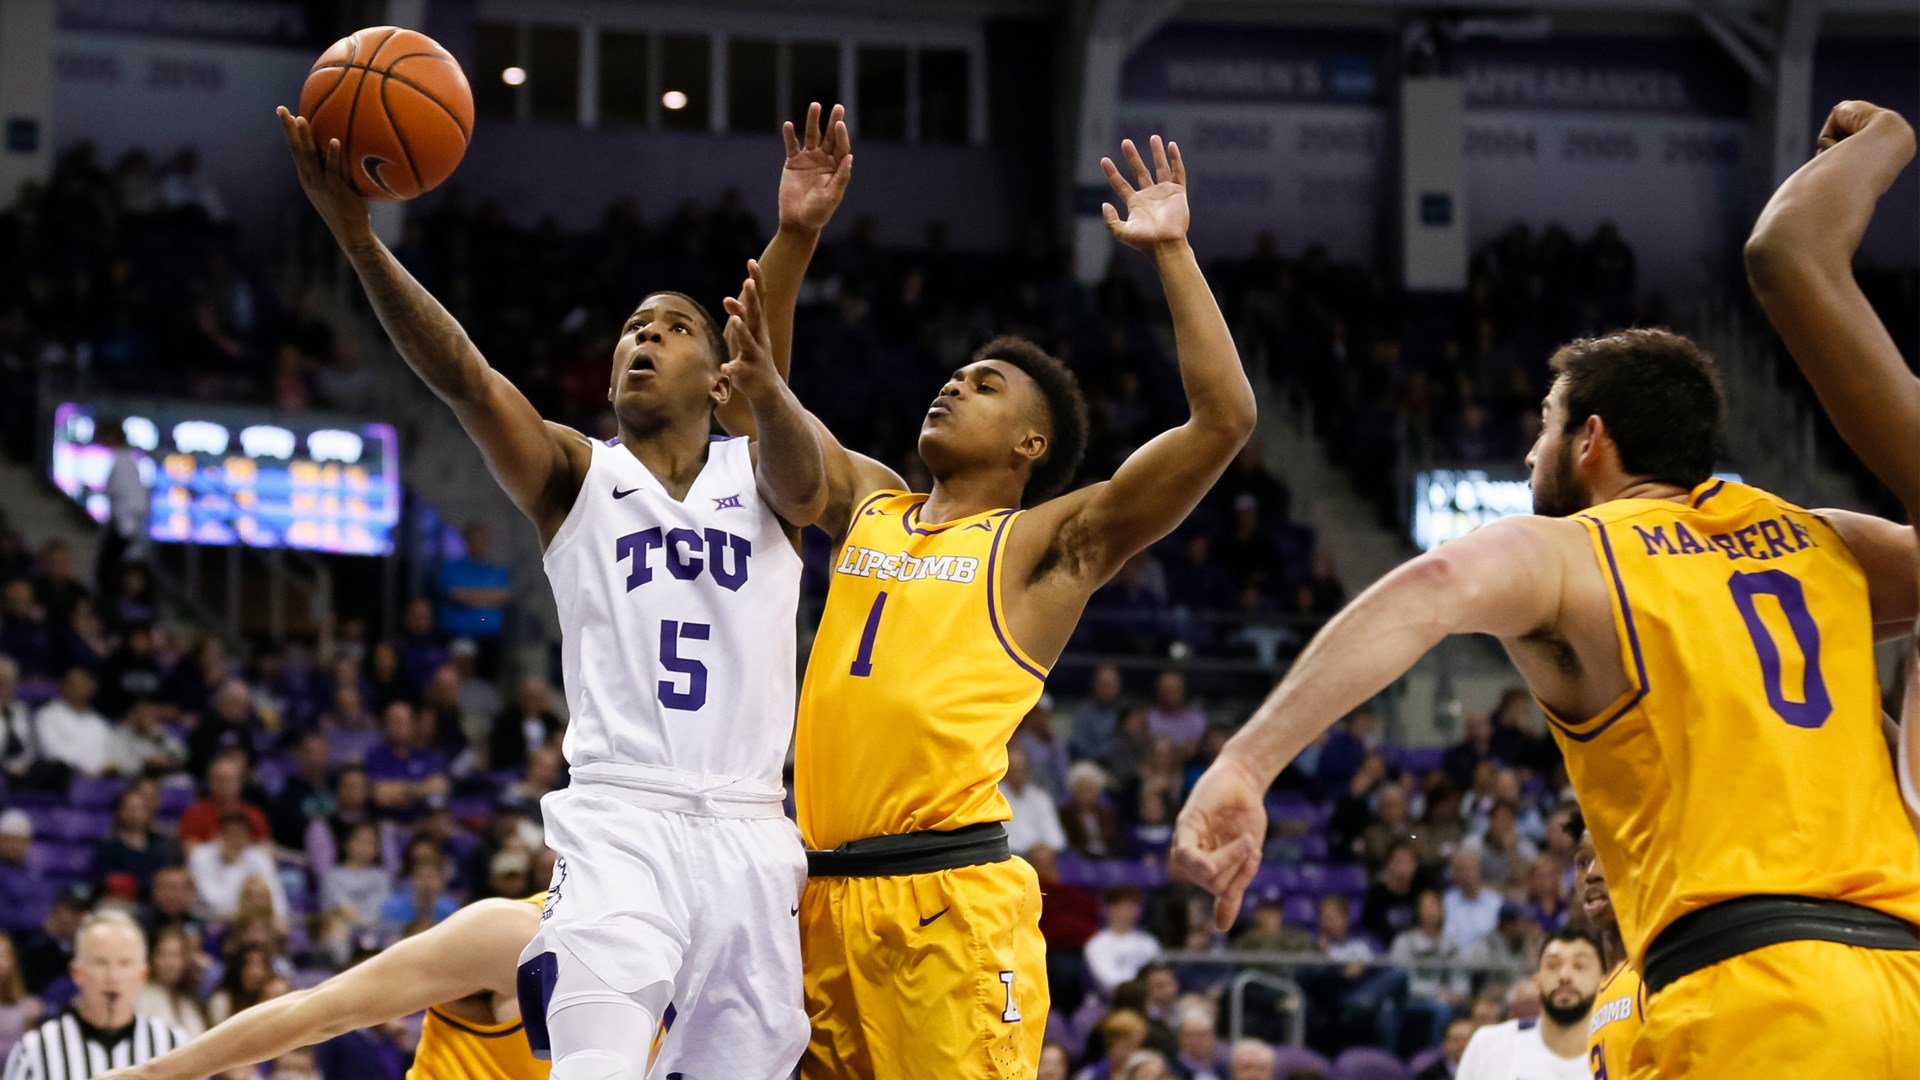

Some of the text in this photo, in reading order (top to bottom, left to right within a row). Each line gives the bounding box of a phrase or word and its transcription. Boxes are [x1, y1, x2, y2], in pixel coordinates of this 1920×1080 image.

[616, 526, 752, 593] TCU
[657, 619, 711, 712] 5
[849, 590, 888, 677] 1
[1727, 569, 1834, 729] 0
